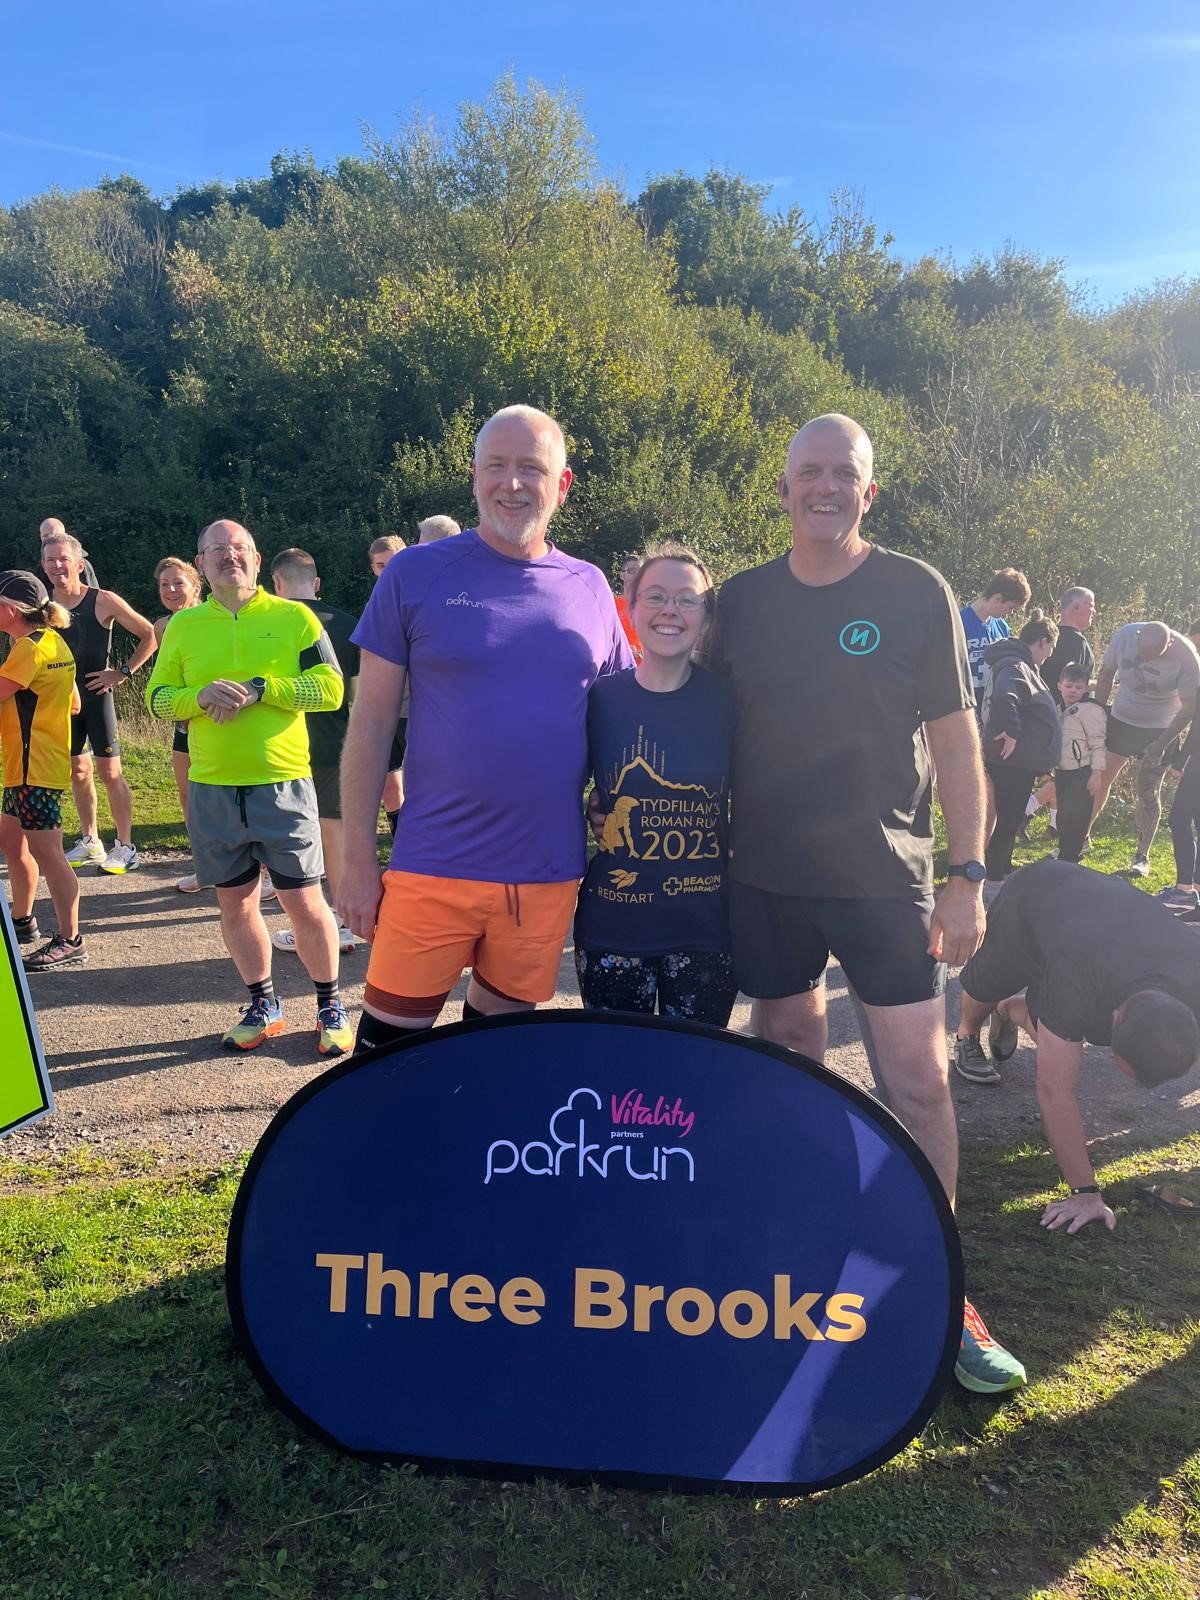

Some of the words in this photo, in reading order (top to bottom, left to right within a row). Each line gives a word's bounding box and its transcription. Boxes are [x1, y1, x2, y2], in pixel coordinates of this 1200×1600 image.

[446, 591, 484, 609] parkrun
[641, 815, 693, 828] ROMAN
[641, 829, 720, 860] 2023
[683, 874, 721, 886] BEACON
[683, 884, 721, 894] PHARMAY
[597, 886, 655, 904] REDSTART
[611, 1088, 695, 1139] Vitality
[483, 1087, 695, 1185] parkrun
[610, 1129, 645, 1139] partners
[315, 1252, 546, 1326] Three
[573, 1267, 868, 1343] Brooks
